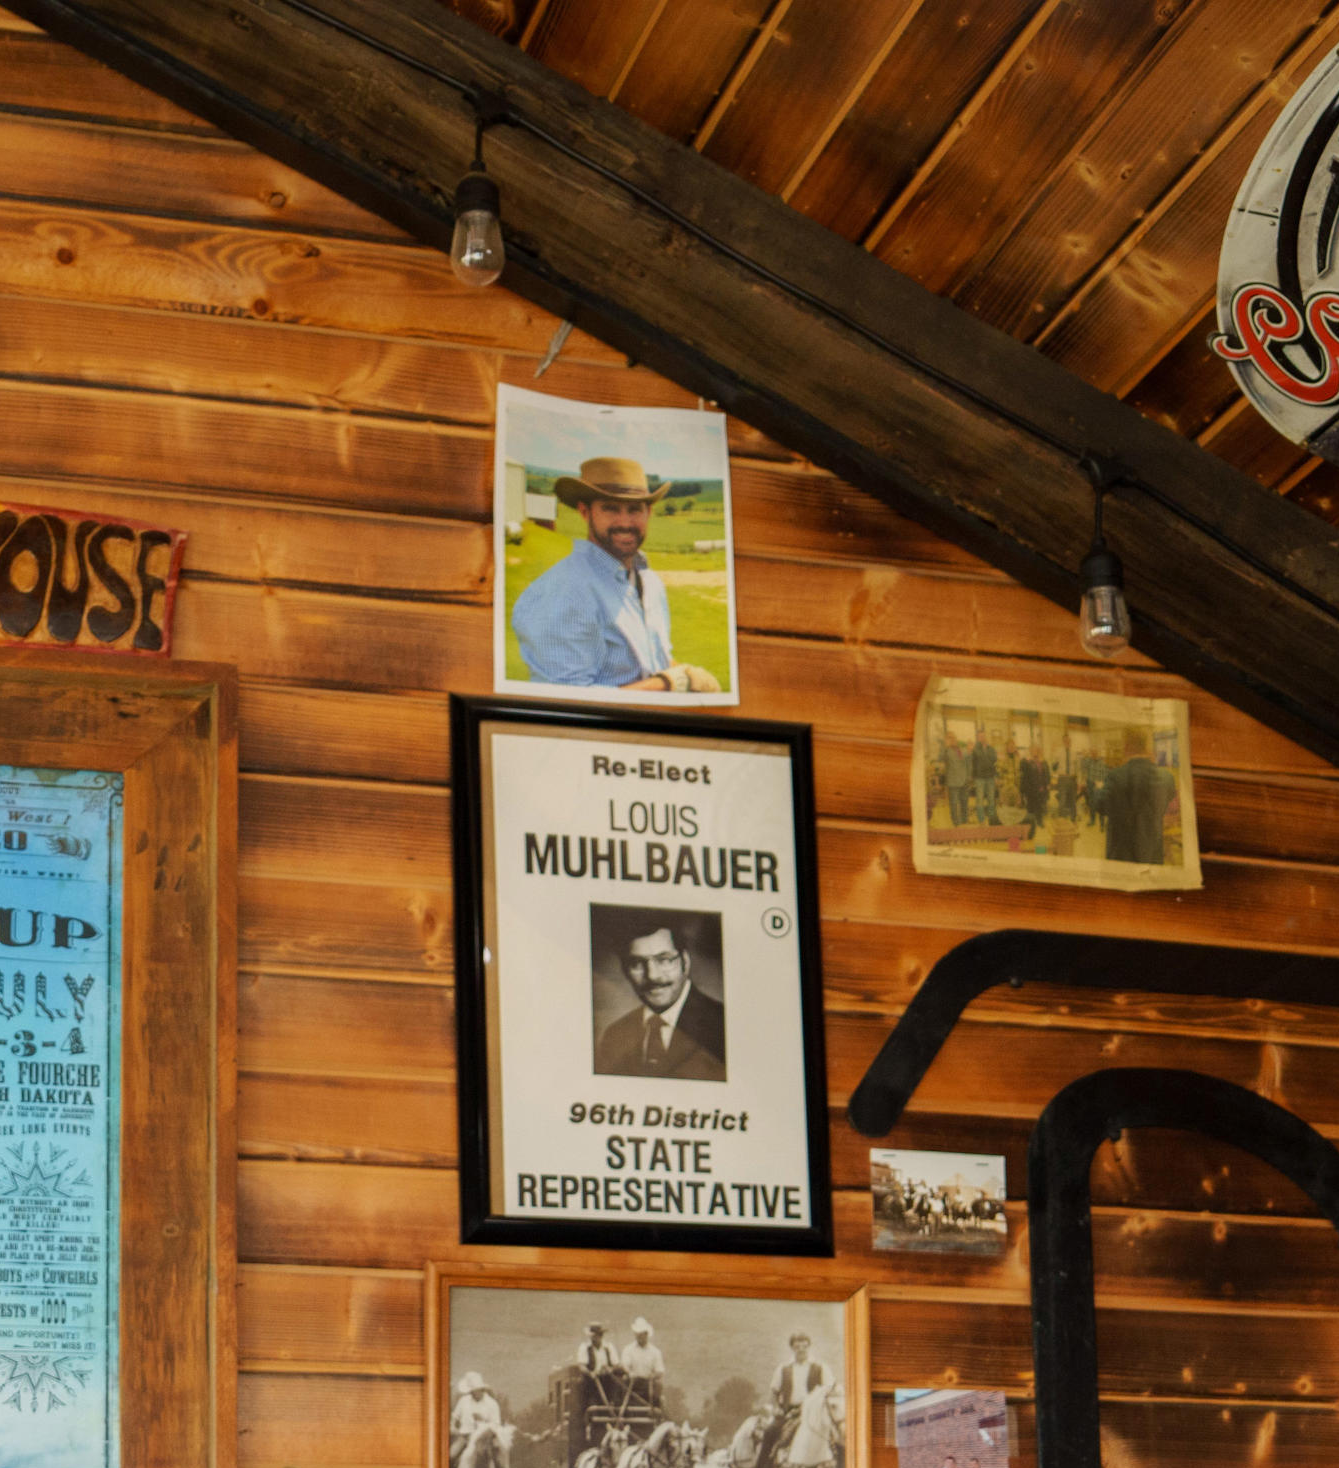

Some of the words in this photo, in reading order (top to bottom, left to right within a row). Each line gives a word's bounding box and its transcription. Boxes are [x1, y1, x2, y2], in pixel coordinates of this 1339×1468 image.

[592, 754, 712, 785] Re-Elect
[607, 798, 700, 839] LOUIS
[523, 831, 780, 893] MUHLBAUER
[17, 1060, 101, 1088] FOURCHE
[21, 1087, 95, 1106] DAKOTA
[568, 1101, 636, 1128] 96th
[641, 1105, 750, 1133] District
[605, 1134, 712, 1175] STATE
[516, 1172, 802, 1221] REPRESENTATIVE
[42, 1267, 98, 1285] COWGIRLS
